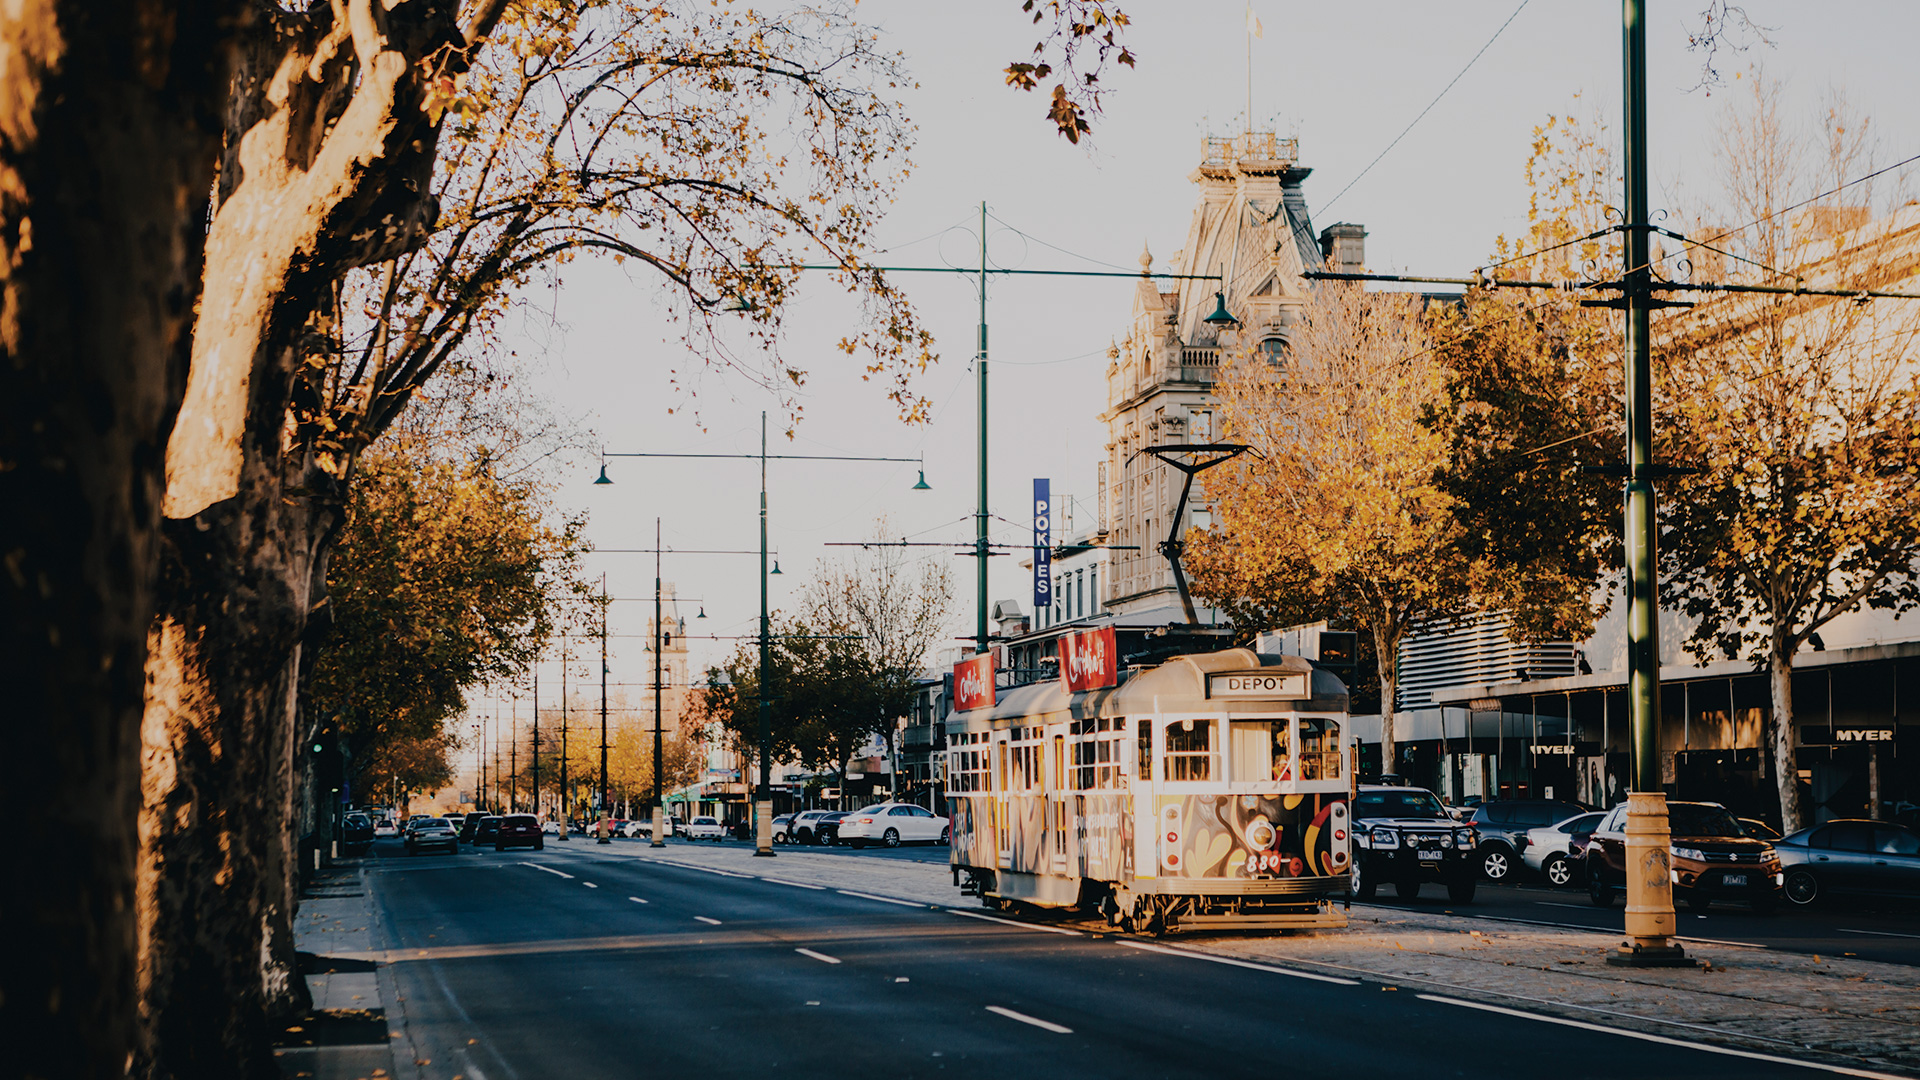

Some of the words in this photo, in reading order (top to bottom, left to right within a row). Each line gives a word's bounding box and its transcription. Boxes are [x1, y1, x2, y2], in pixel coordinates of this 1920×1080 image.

[1035, 500, 1049, 594] POKIES
[1228, 677, 1287, 690] DEPOT
[1836, 729, 1893, 741] MYER
